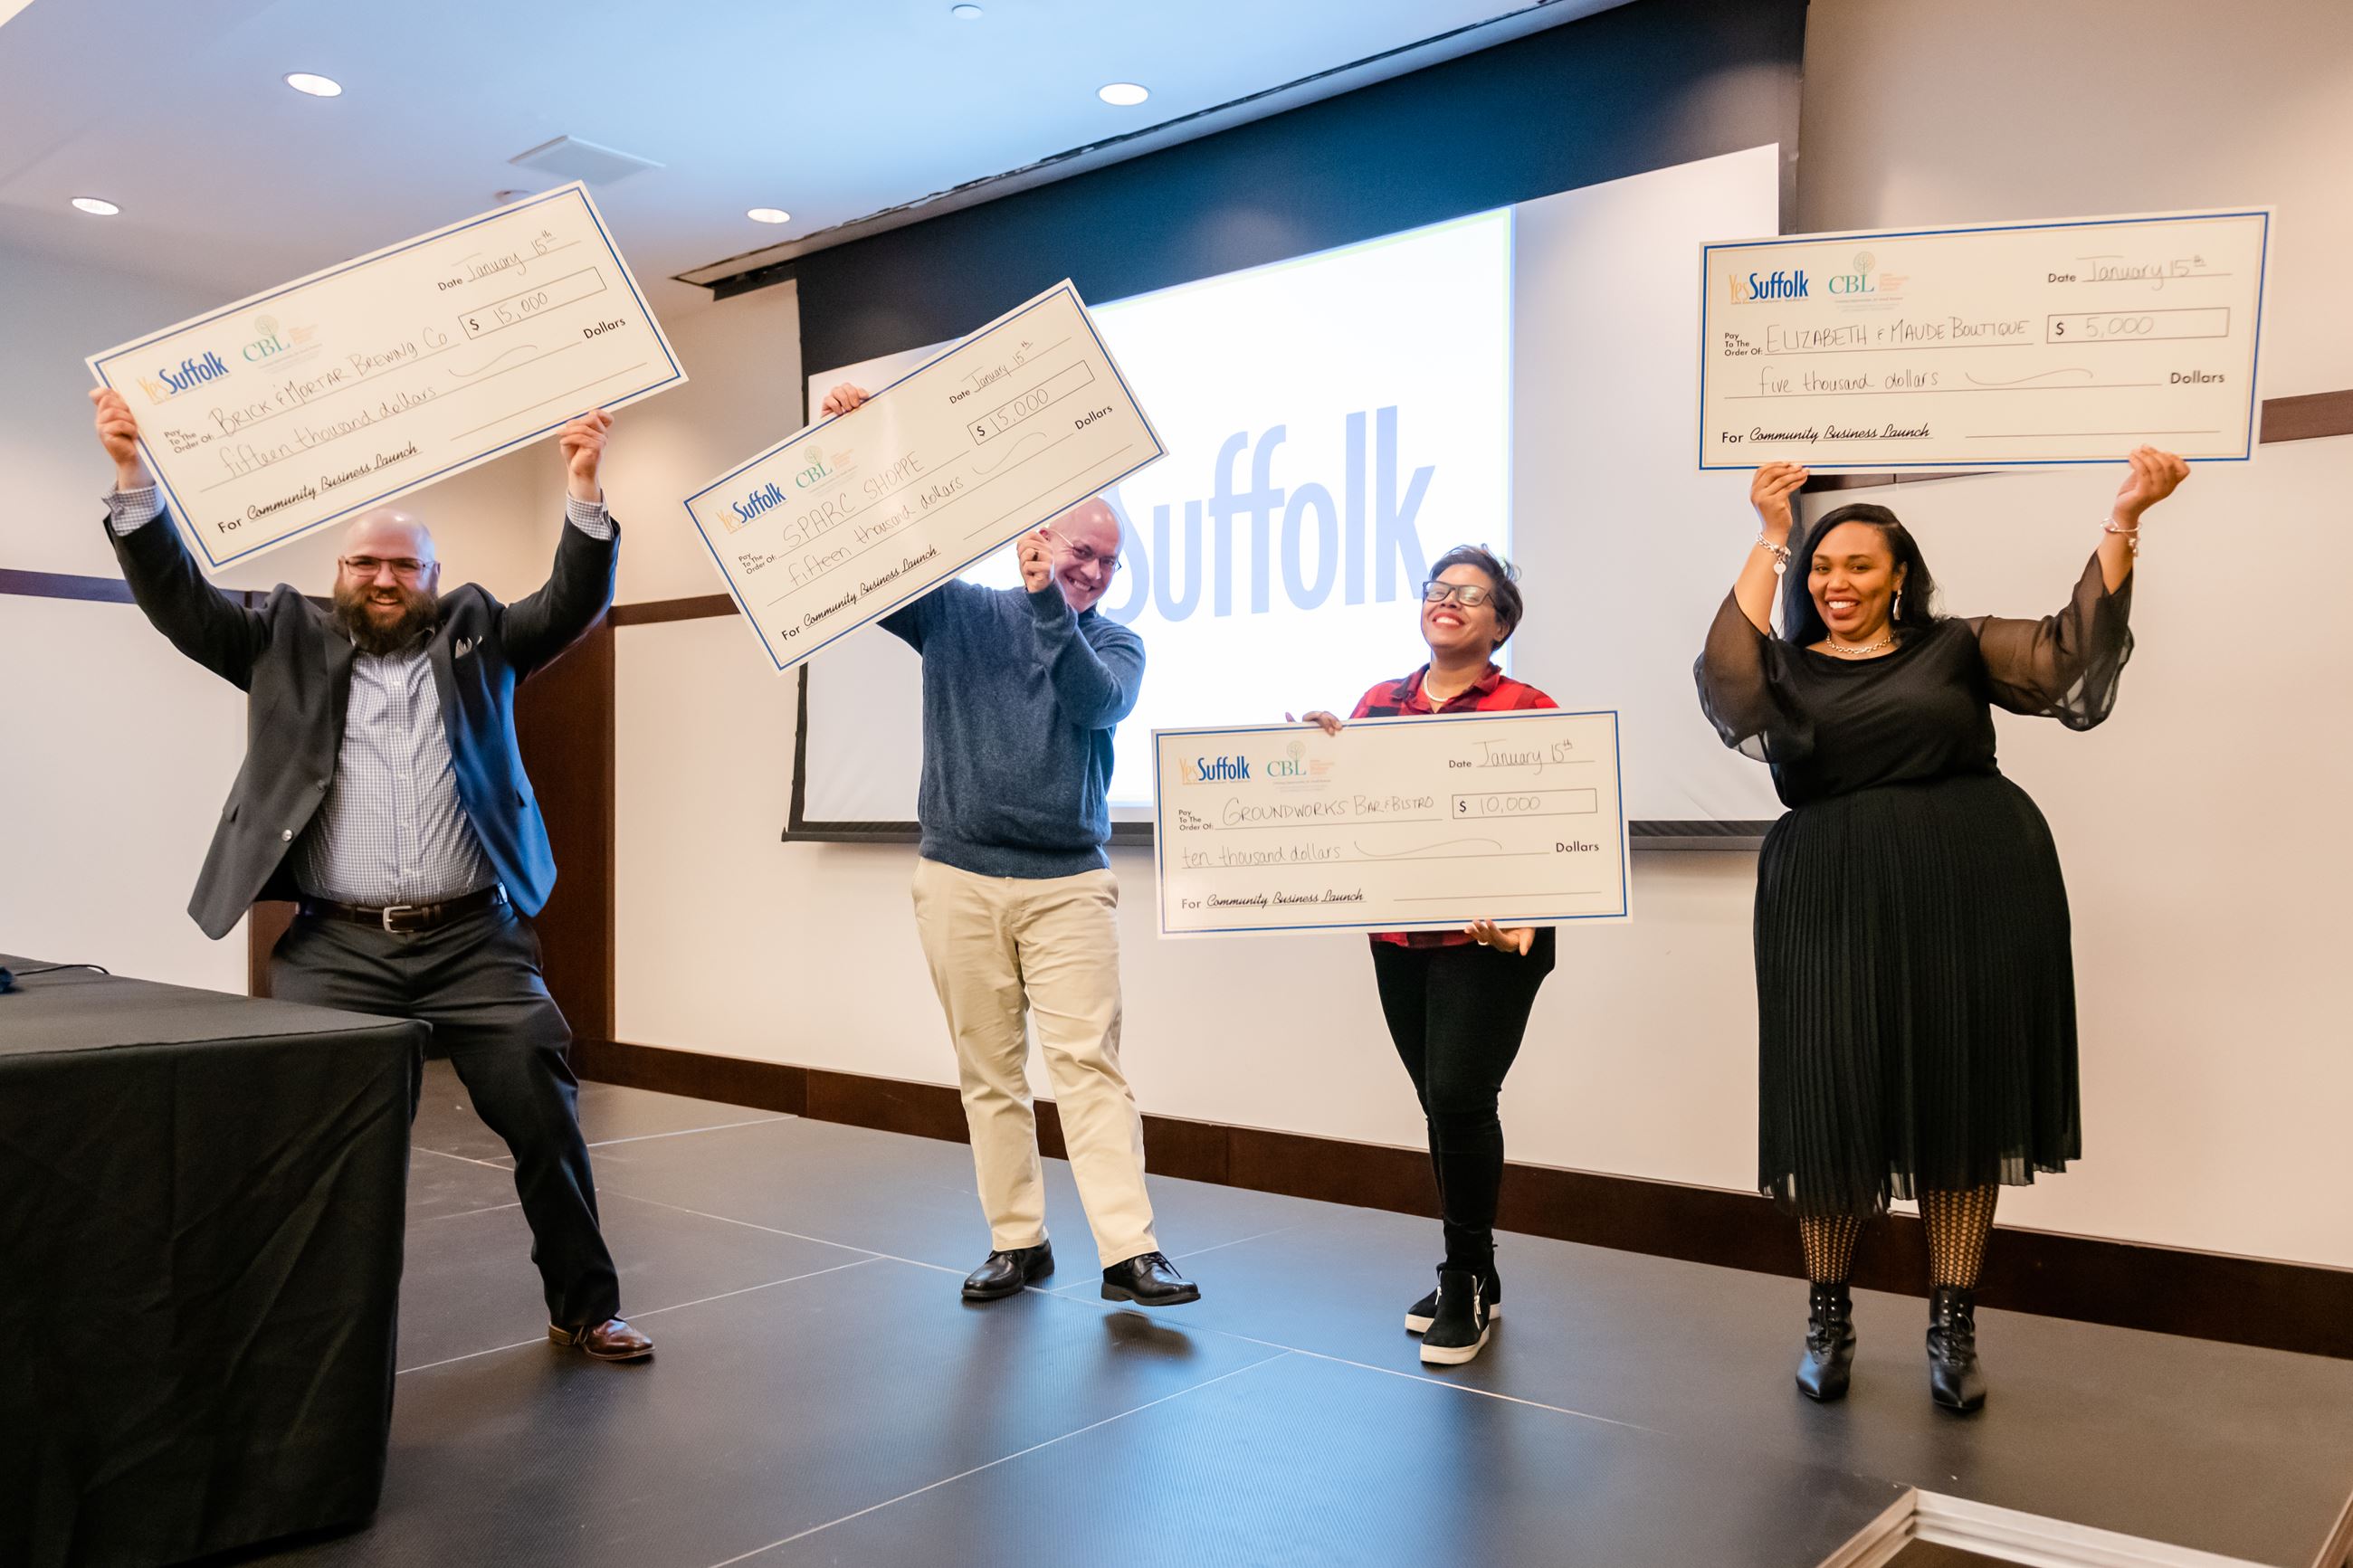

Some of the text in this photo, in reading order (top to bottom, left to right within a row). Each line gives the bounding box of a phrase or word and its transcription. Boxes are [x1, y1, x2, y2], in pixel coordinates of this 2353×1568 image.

[438, 278, 462, 290] Date
[452, 252, 527, 282] January
[2048, 273, 2076, 283] Date
[2077, 255, 2164, 291] January
[1828, 274, 1875, 294] CBL
[583, 317, 625, 339] Dollars
[1724, 333, 1739, 341] Pay
[243, 335, 291, 363] CBL
[1724, 348, 1748, 356] Order
[949, 390, 970, 404] Date
[961, 365, 1011, 393] January
[2170, 371, 2225, 385] Dollars
[1075, 405, 1113, 430] Dollars
[164, 429, 181, 439] Pay
[169, 432, 197, 446] To The
[1722, 423, 1930, 443] For Community Business Launch
[174, 441, 199, 454] Order
[795, 461, 834, 489] CBL
[217, 441, 417, 534] For Community Business Launch
[738, 553, 751, 562] Pay
[751, 555, 763, 564] The
[746, 561, 765, 575] Order
[782, 544, 938, 641] For Community Business Launch
[1449, 760, 1472, 768] Date
[1472, 739, 1543, 775] January
[1267, 760, 1306, 777] CBL
[1223, 797, 1348, 826] GROUNDWORKS
[1556, 841, 1599, 853] Dollars
[1181, 888, 1363, 909] For Community Business Launch
